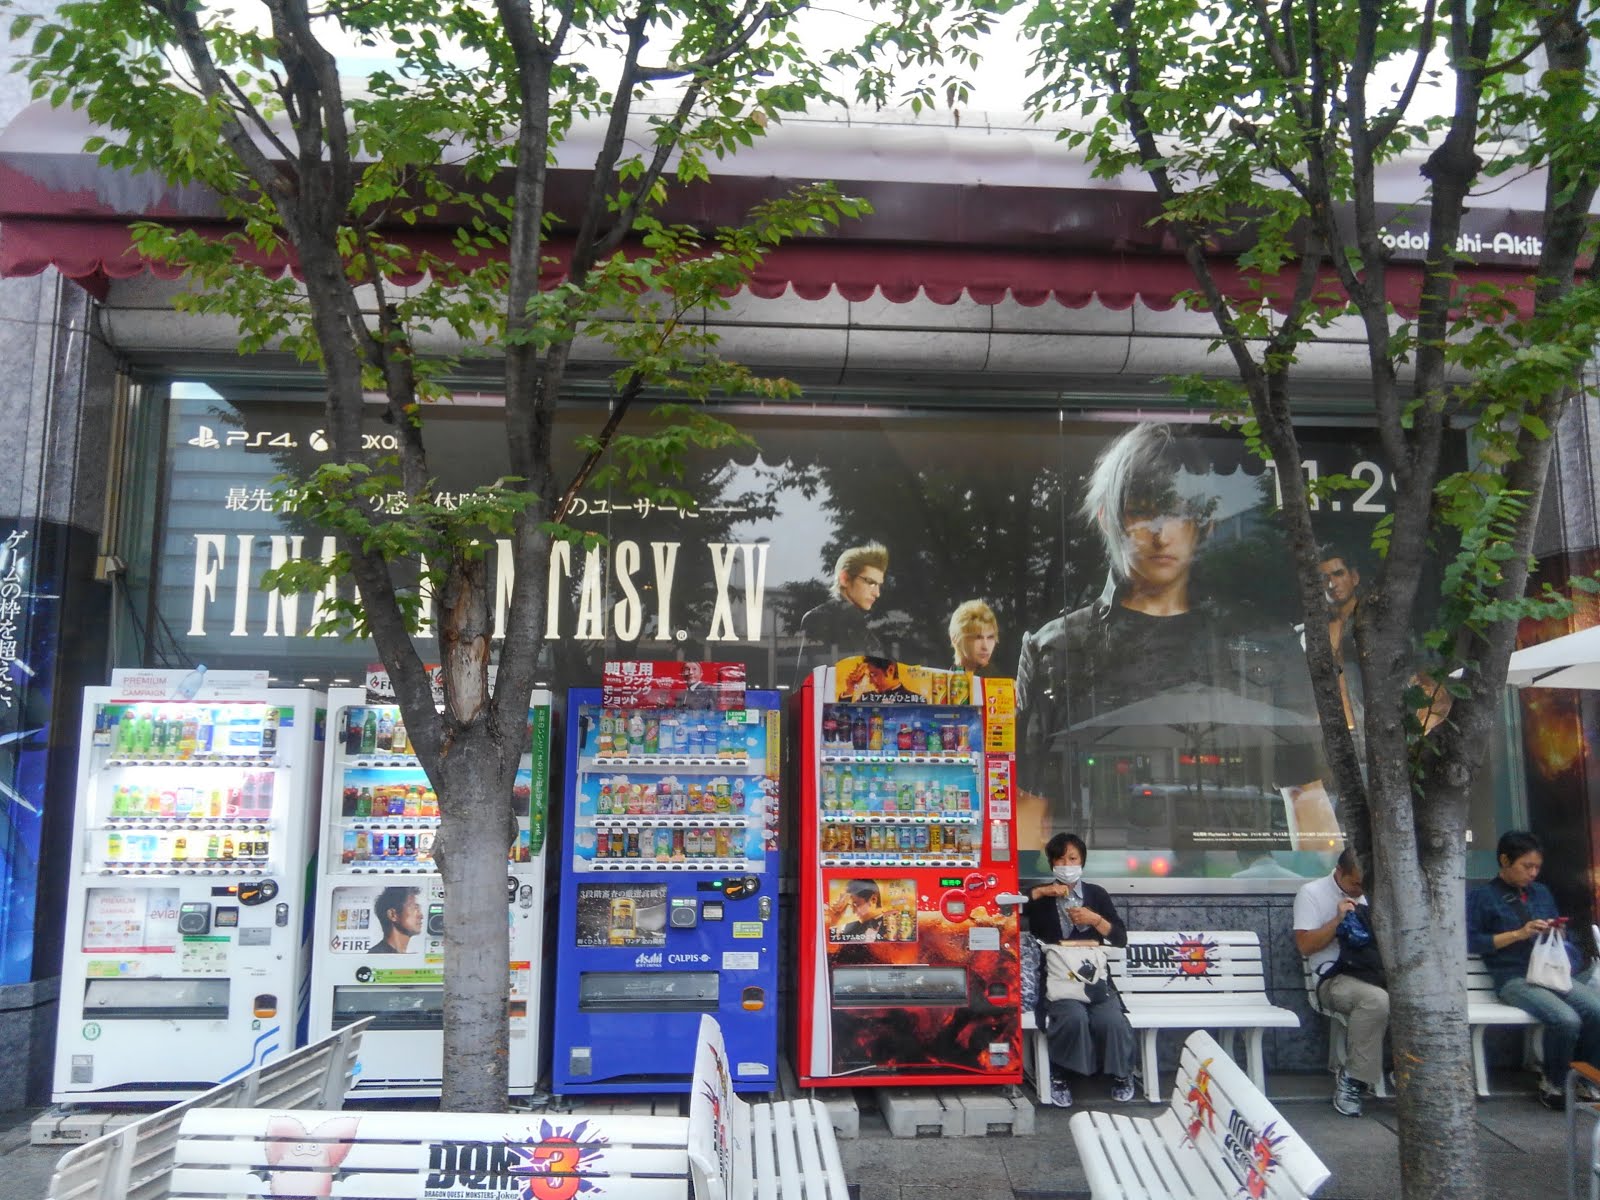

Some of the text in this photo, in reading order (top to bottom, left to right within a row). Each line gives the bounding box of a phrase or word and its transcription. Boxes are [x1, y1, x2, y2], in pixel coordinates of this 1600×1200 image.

[226, 431, 291, 448] PS4
[1265, 459, 1397, 513] 11.2
[187, 534, 372, 637] FINA
[706, 543, 770, 641] XV
[604, 662, 653, 675] 朝専用
[122, 689, 166, 697] CAMPAIGN
[604, 686, 651, 695] モーニング
[603, 696, 638, 705] ショット
[861, 693, 926, 704] レミアムなひと時を
[342, 941, 370, 951] FIRE
[635, 952, 699, 964] Asahi CALPIS
[425, 1137, 581, 1200] DQM 3
[424, 1190, 446, 1198] DRAGON
